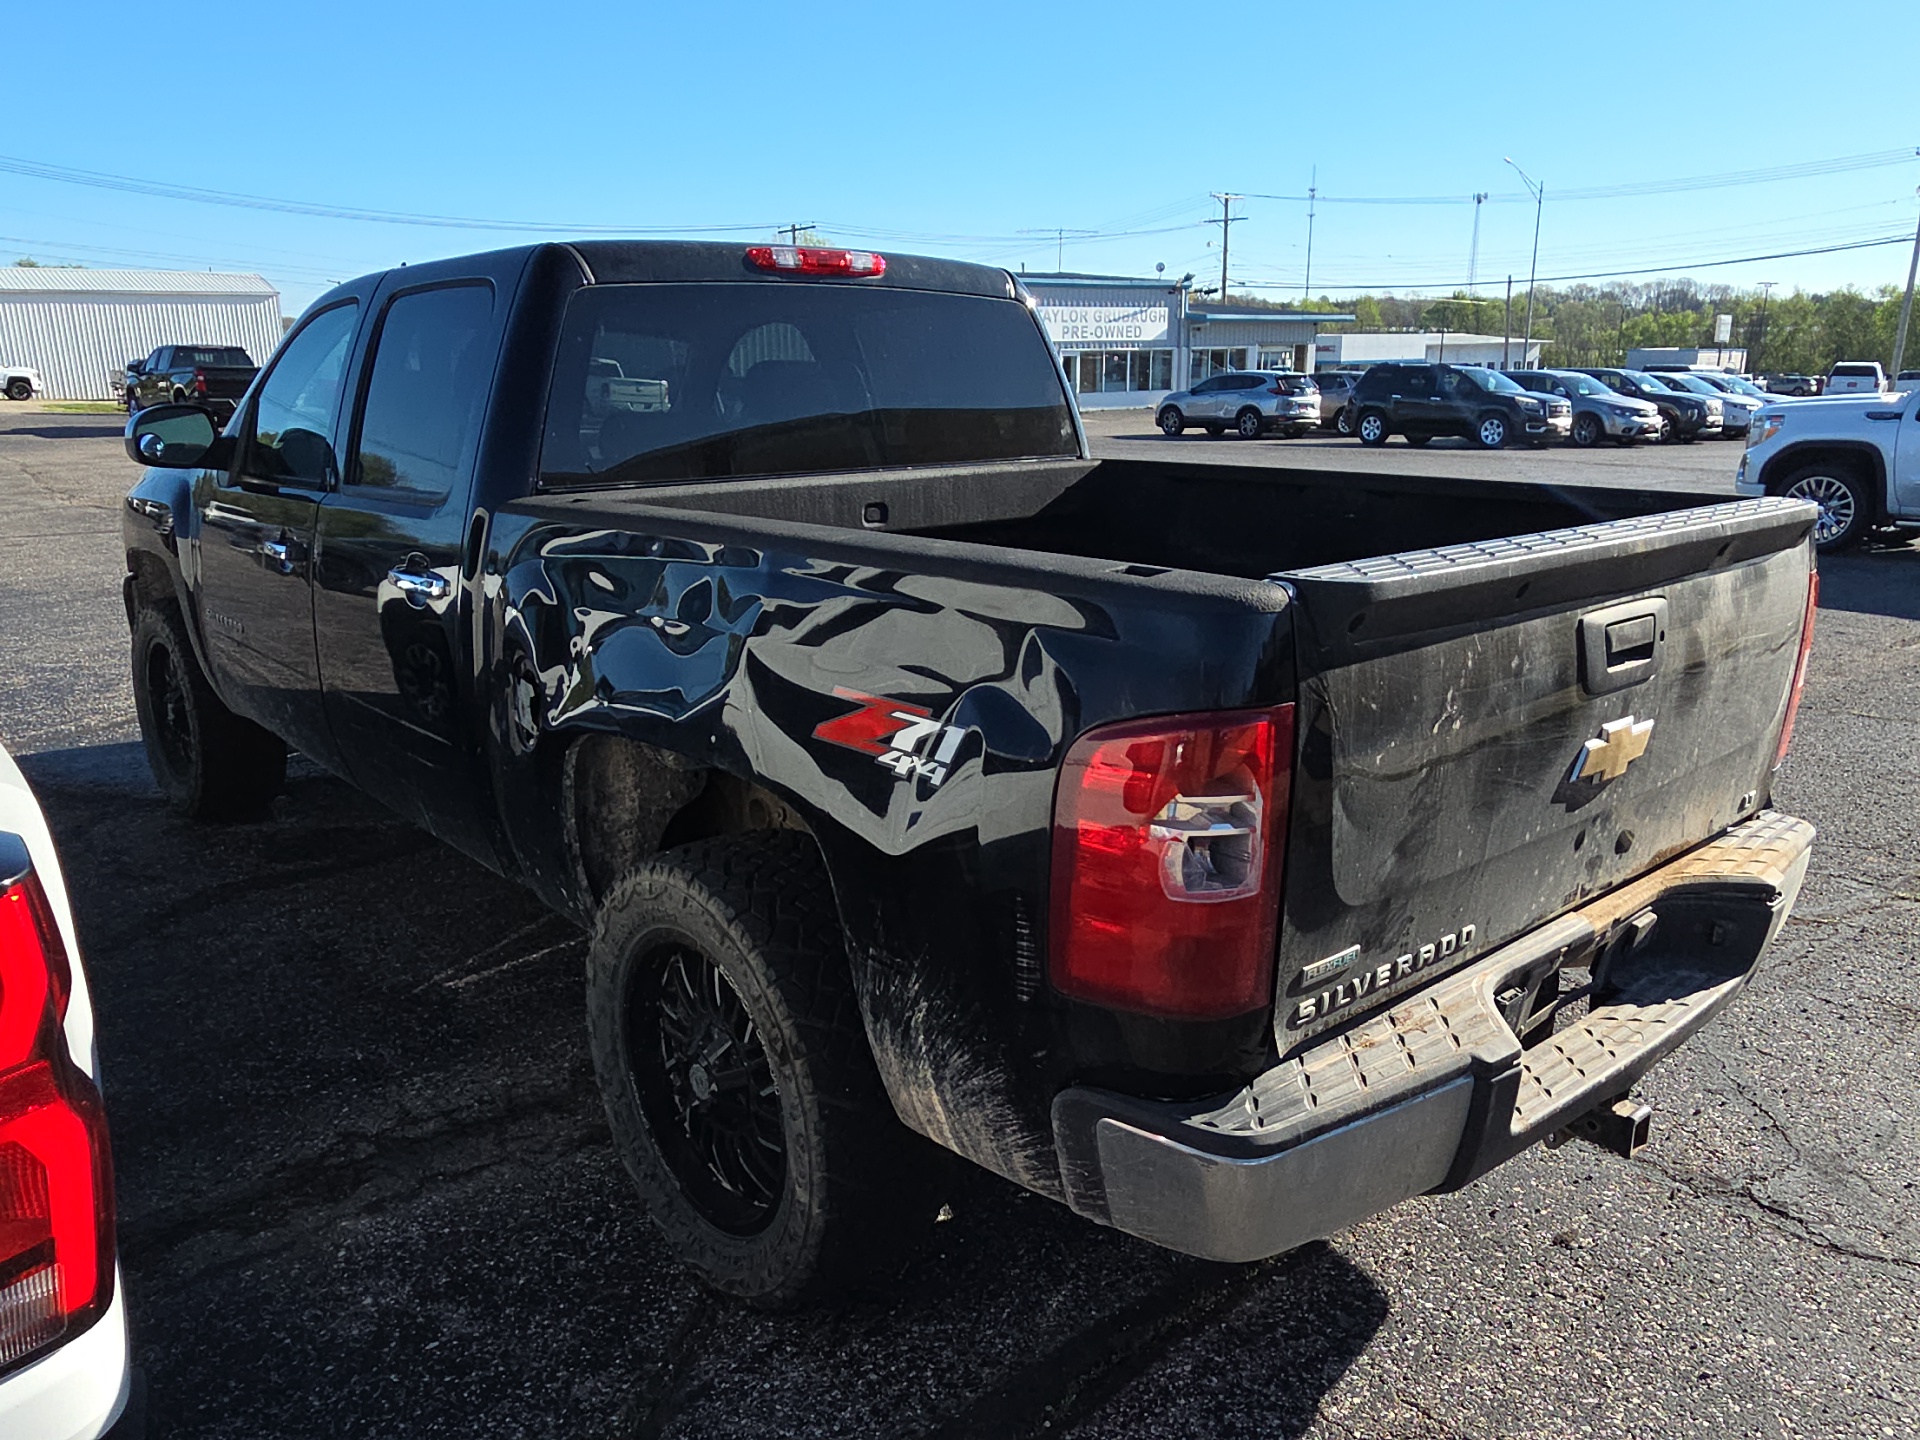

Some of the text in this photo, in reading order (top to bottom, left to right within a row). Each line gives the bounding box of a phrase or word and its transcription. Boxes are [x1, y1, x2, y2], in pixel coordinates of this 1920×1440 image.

[1040, 309, 1088, 323] AYLOR
[1062, 325, 1142, 339] PRE-OWNED
[811, 685, 968, 765] Z71
[1296, 923, 1477, 1025] SILVERADO
